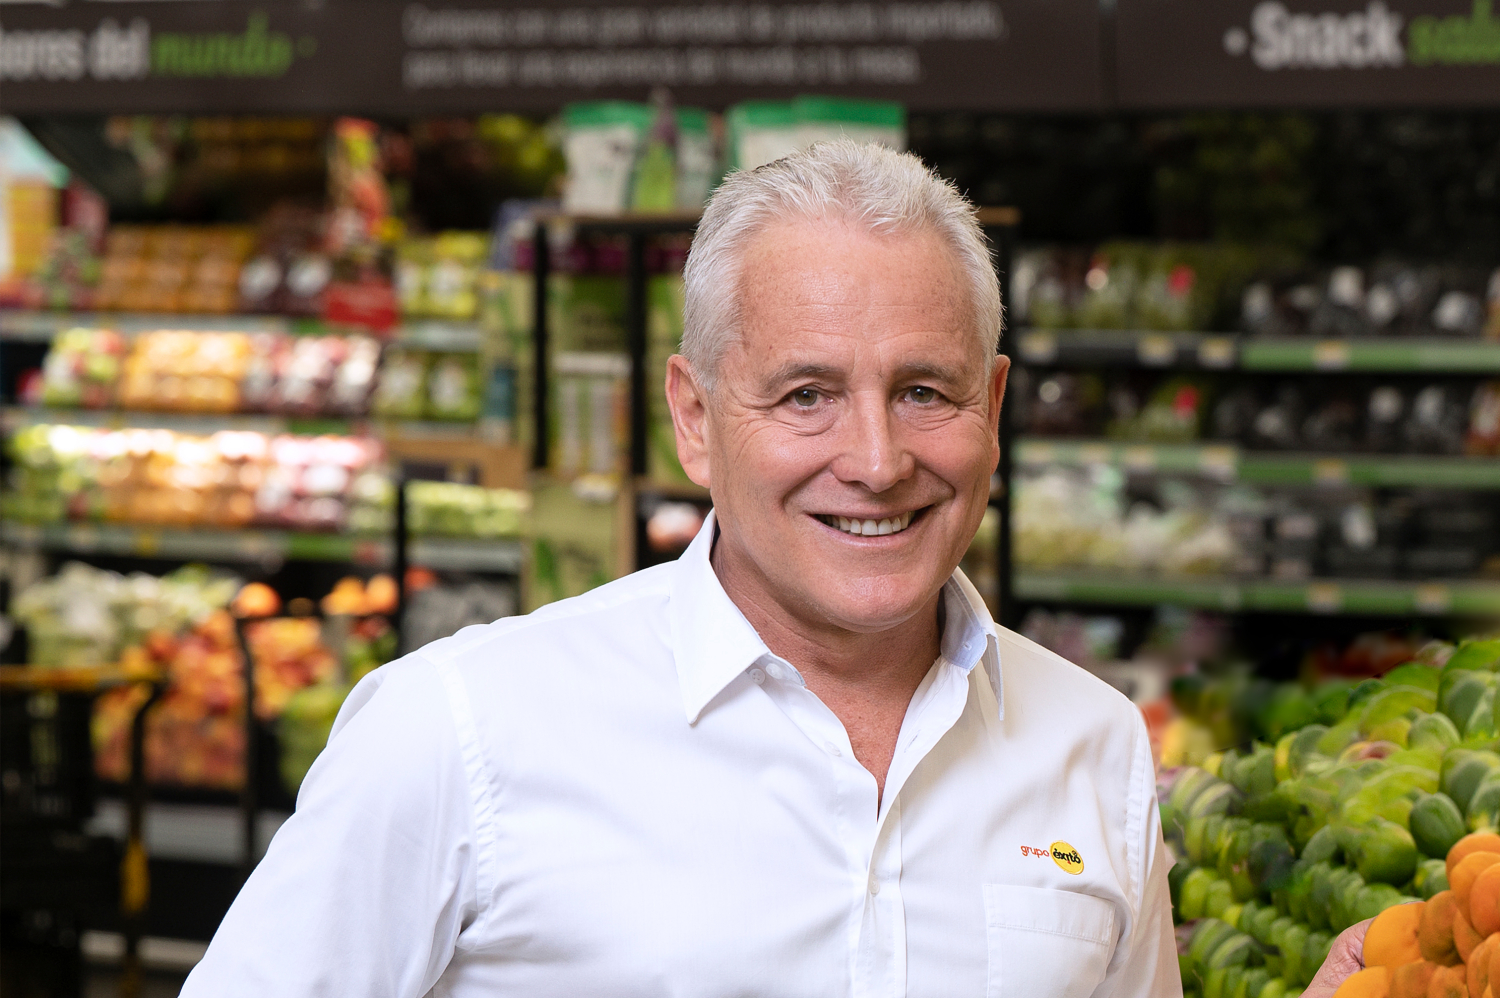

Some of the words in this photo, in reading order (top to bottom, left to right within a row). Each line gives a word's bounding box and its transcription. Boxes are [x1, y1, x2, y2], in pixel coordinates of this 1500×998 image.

[90, 18, 149, 79] del
[152, 12, 292, 77] mundo
[1252, 3, 1404, 68] Snack
[1020, 845, 1050, 858] grupo
